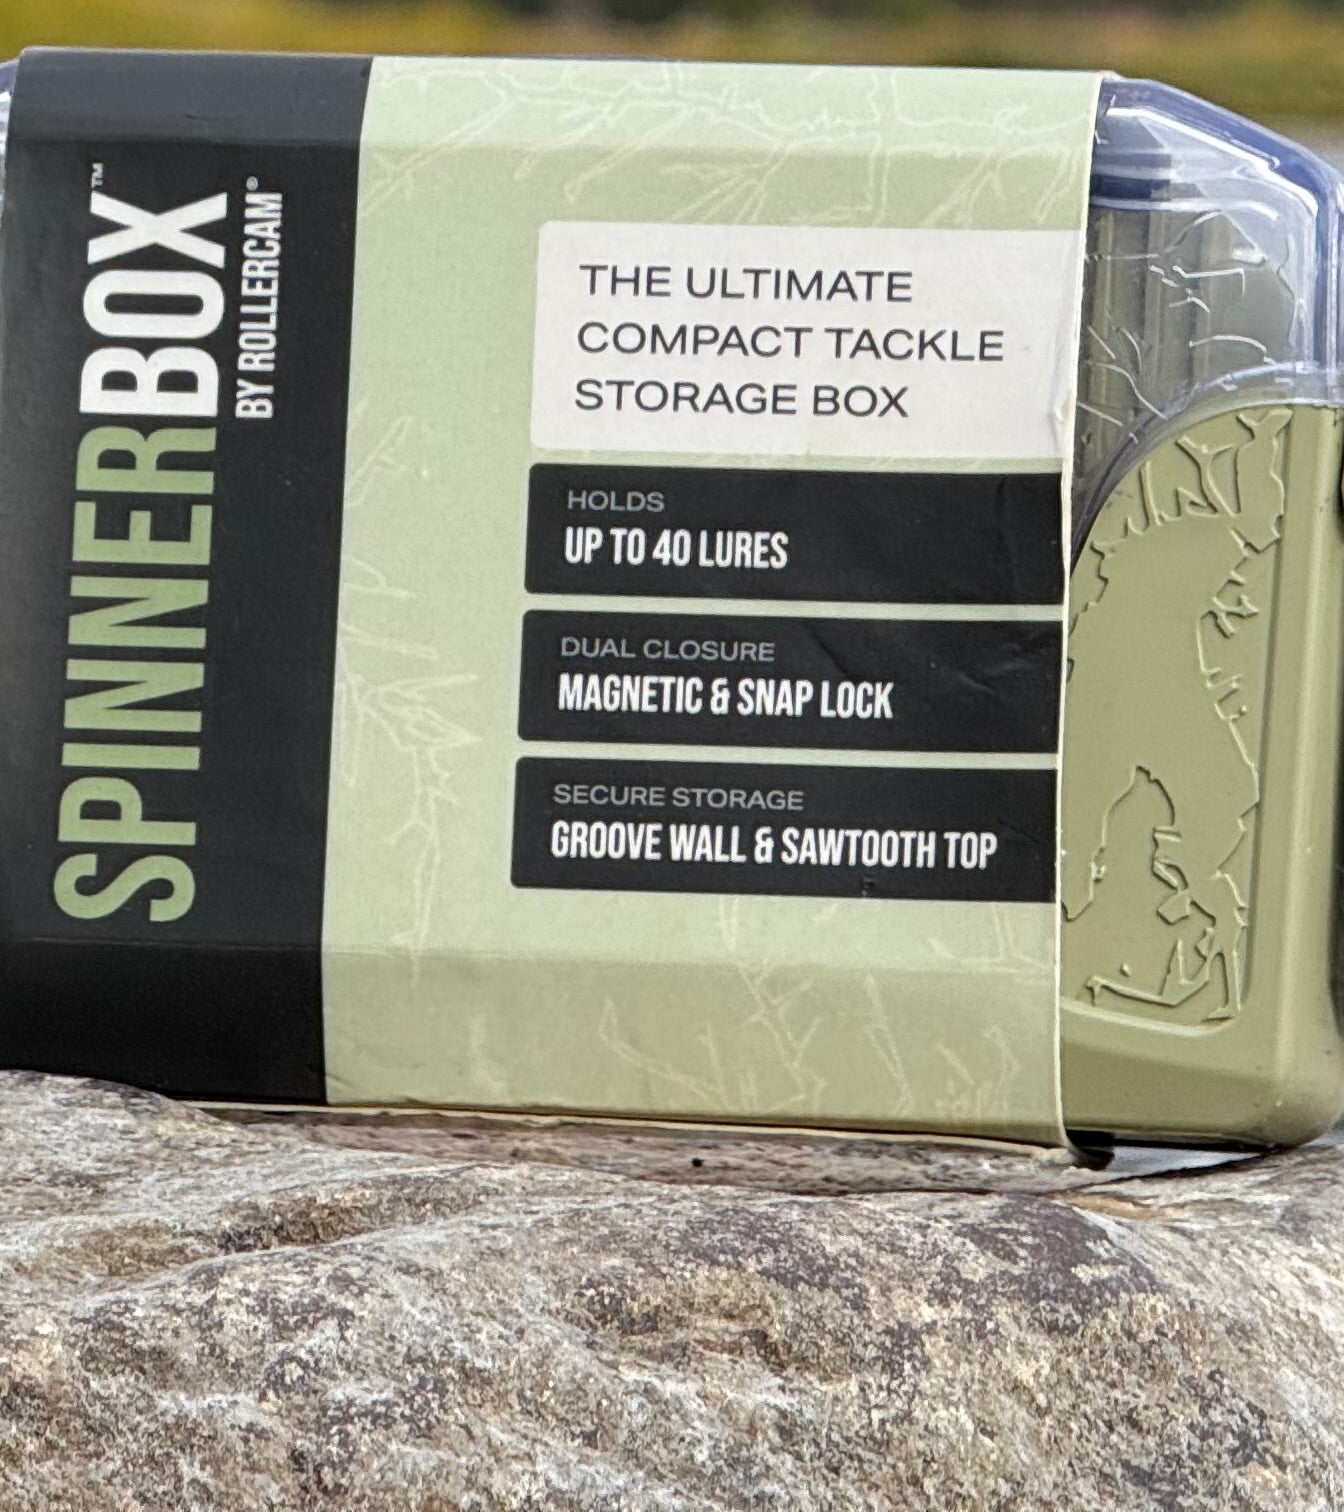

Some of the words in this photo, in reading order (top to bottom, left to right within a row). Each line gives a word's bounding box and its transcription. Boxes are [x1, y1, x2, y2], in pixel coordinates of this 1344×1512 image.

[579, 264, 672, 298] THE
[686, 266, 914, 303] ULTIMATE
[577, 321, 813, 358] COMPACT
[824, 327, 1005, 362] TACKLE
[234, 377, 275, 420] BY
[574, 379, 797, 415] STORAGE
[813, 386, 909, 418] BOX
[567, 490, 665, 513] HOLDS
[564, 527, 601, 565] UP
[610, 528, 646, 567] TO
[652, 529, 692, 567] 40
[698, 531, 789, 570] LURES
[561, 637, 636, 659] DUAL
[642, 639, 775, 662] CLOSURE
[558, 672, 703, 713] MAGNETIC
[710, 678, 730, 715] &
[736, 679, 812, 717] SNAP
[820, 681, 894, 719] LOCK
[553, 784, 665, 807] SECURE
[671, 787, 804, 810] STORAGE
[551, 820, 661, 860] GROOVE
[669, 824, 746, 863] WALL
[754, 827, 775, 864] &
[781, 828, 936, 869] SAWTOOTH
[943, 831, 999, 870] TOP
